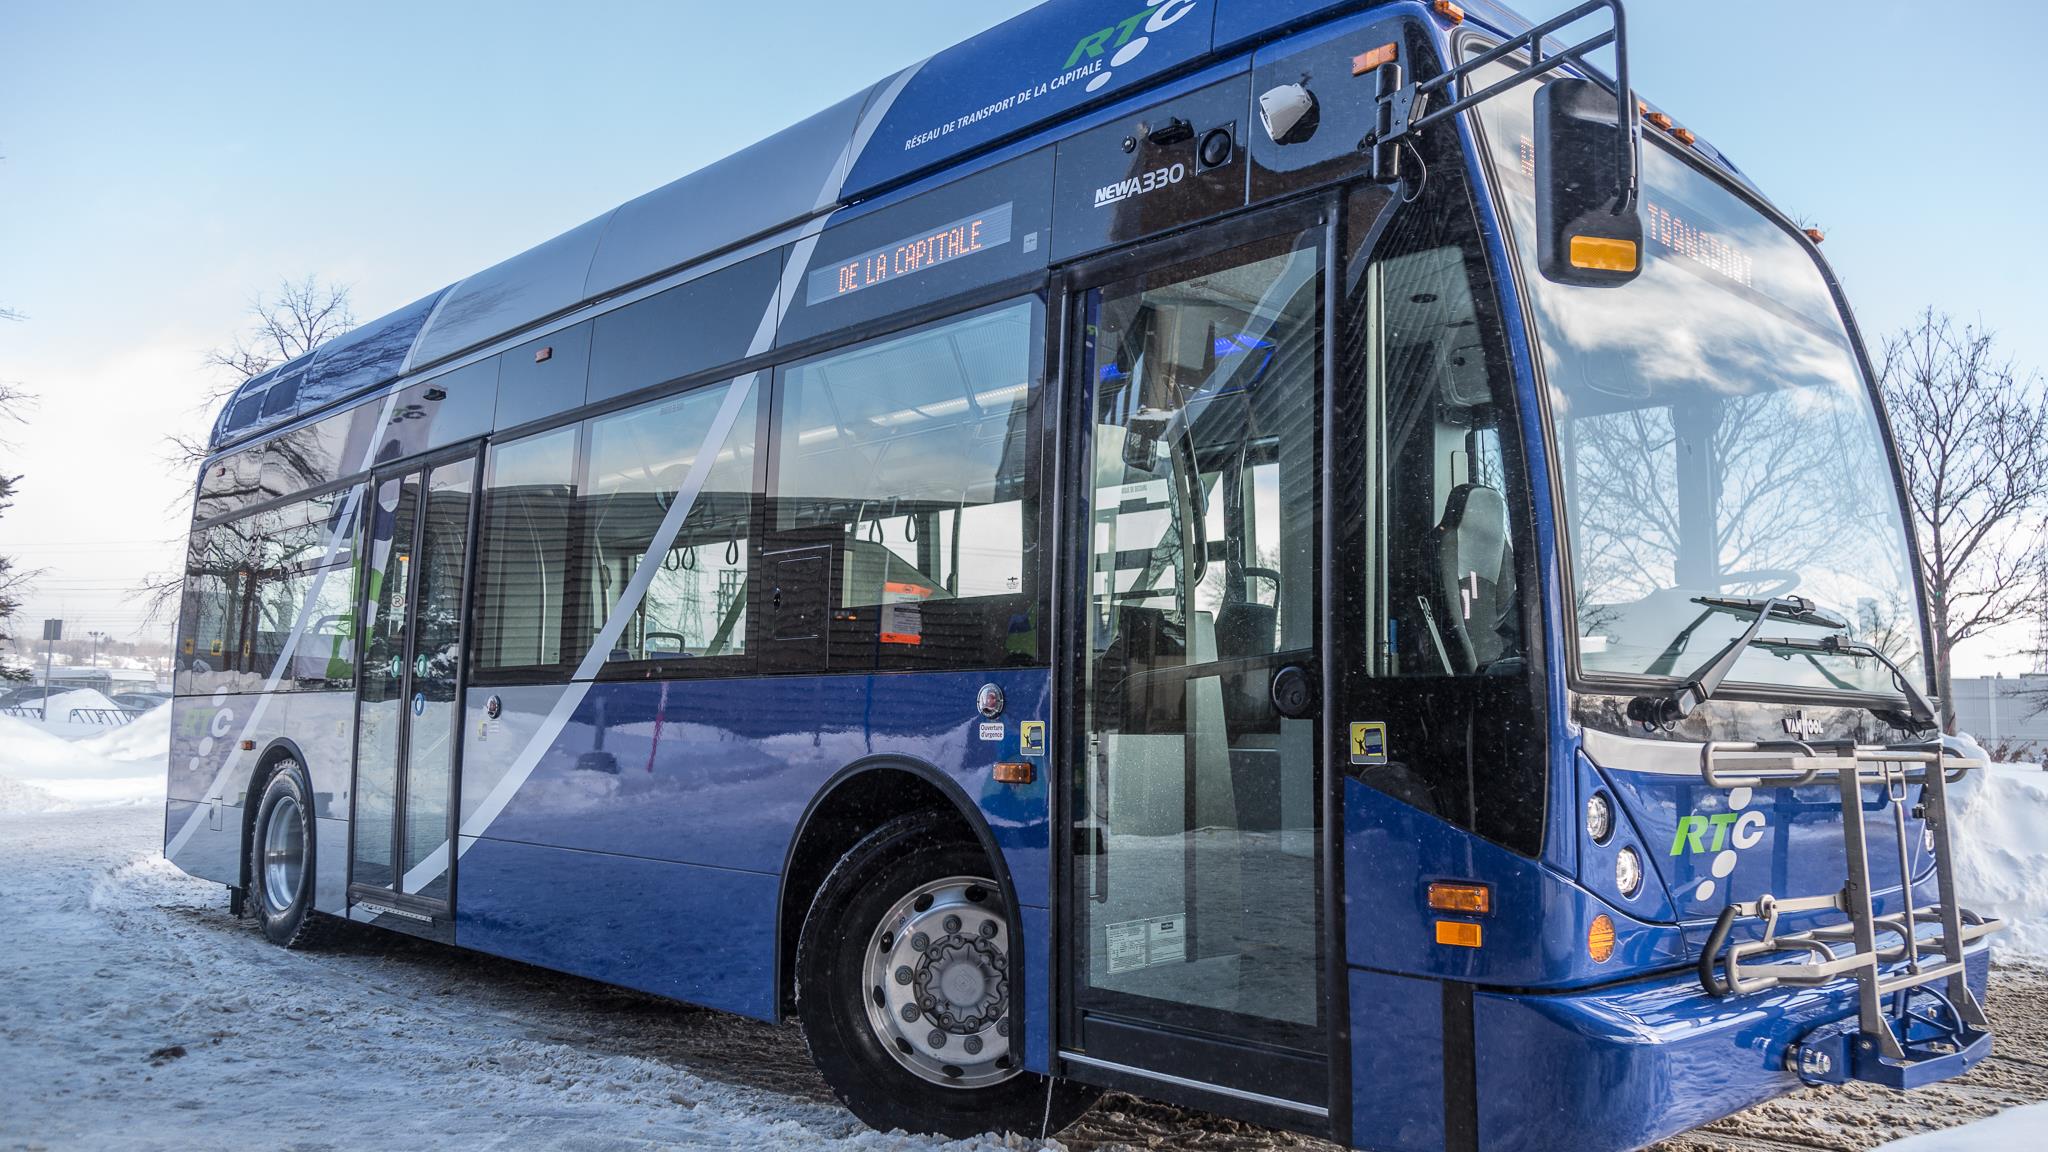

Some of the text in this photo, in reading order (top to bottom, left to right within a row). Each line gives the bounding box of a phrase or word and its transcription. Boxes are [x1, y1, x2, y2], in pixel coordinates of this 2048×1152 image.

[1062, 0, 1198, 70] RTC
[904, 59, 1103, 151] RÉSEAU DE TRANSPORT DE LA CAPITALE
[838, 219, 983, 293] DE LA CAPITALE
[1669, 810, 1766, 857] RTC
